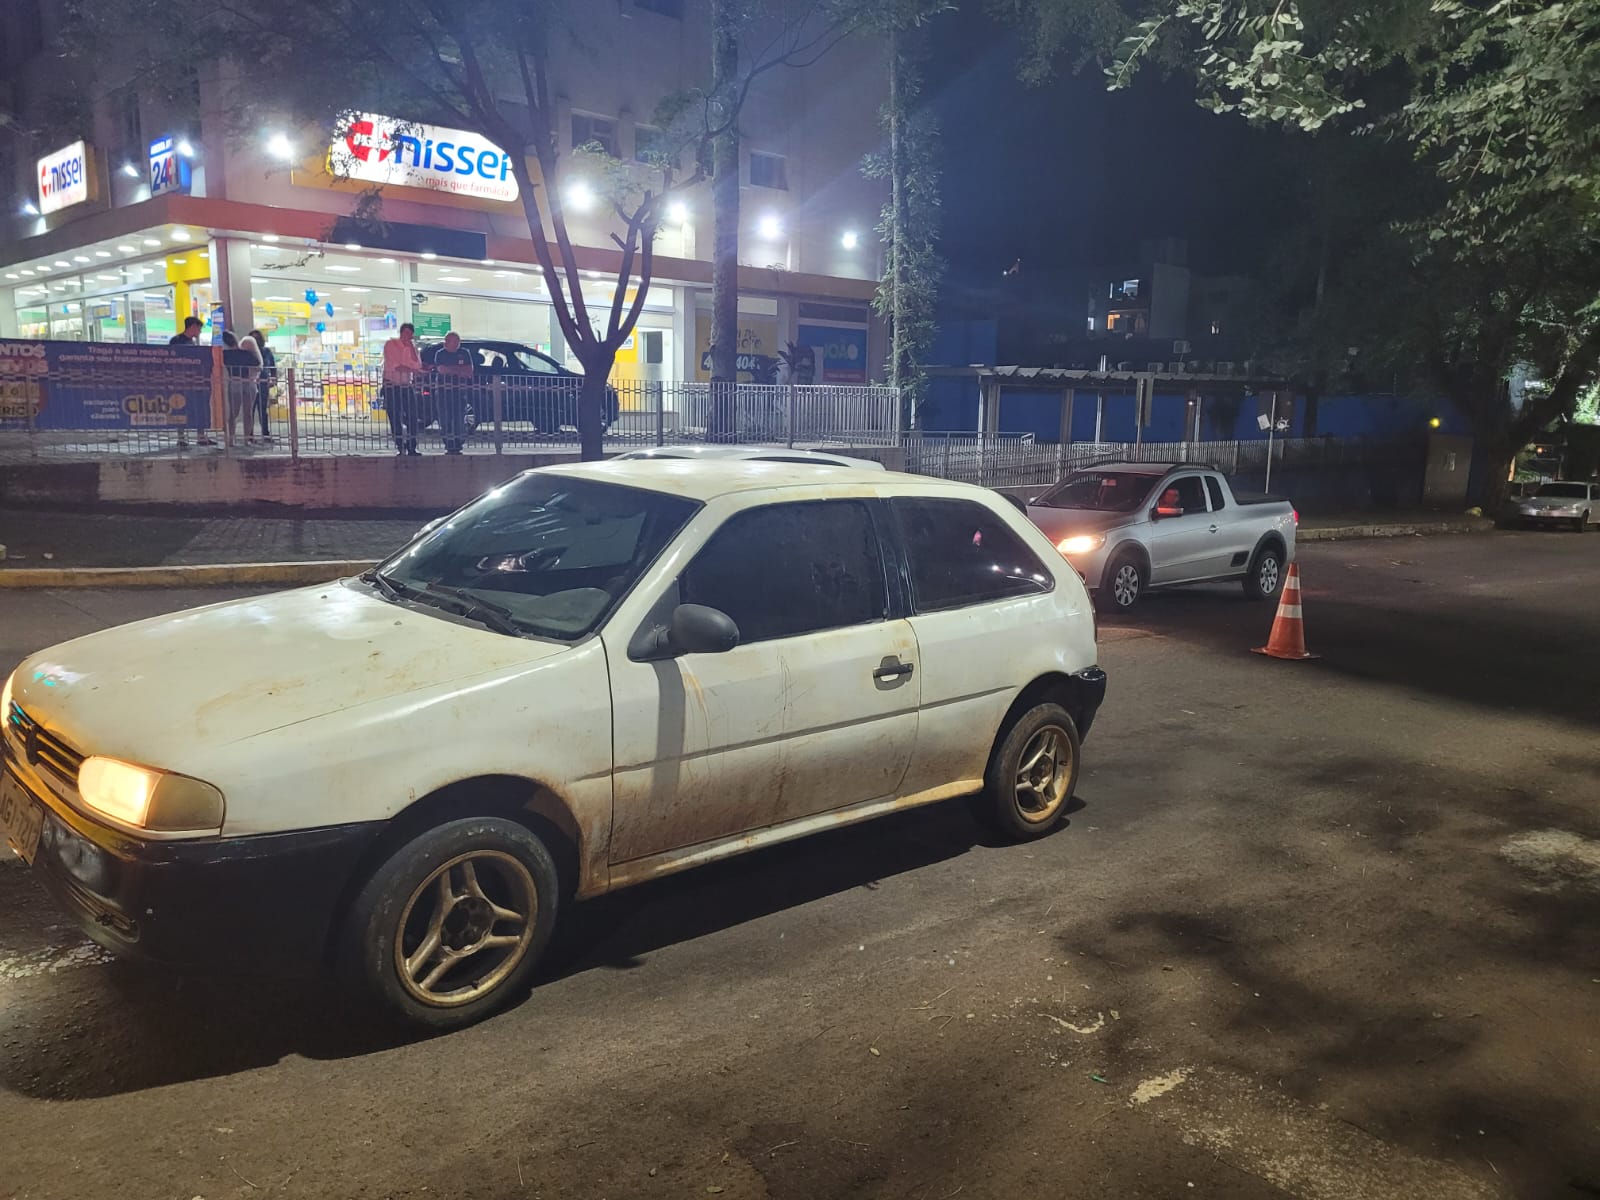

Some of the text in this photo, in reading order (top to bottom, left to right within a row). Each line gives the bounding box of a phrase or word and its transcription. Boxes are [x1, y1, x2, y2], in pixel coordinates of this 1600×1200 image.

[51, 157, 83, 193] nissei
[395, 134, 511, 182] nissei
[425, 177, 448, 187] mais
[450, 180, 469, 191] que
